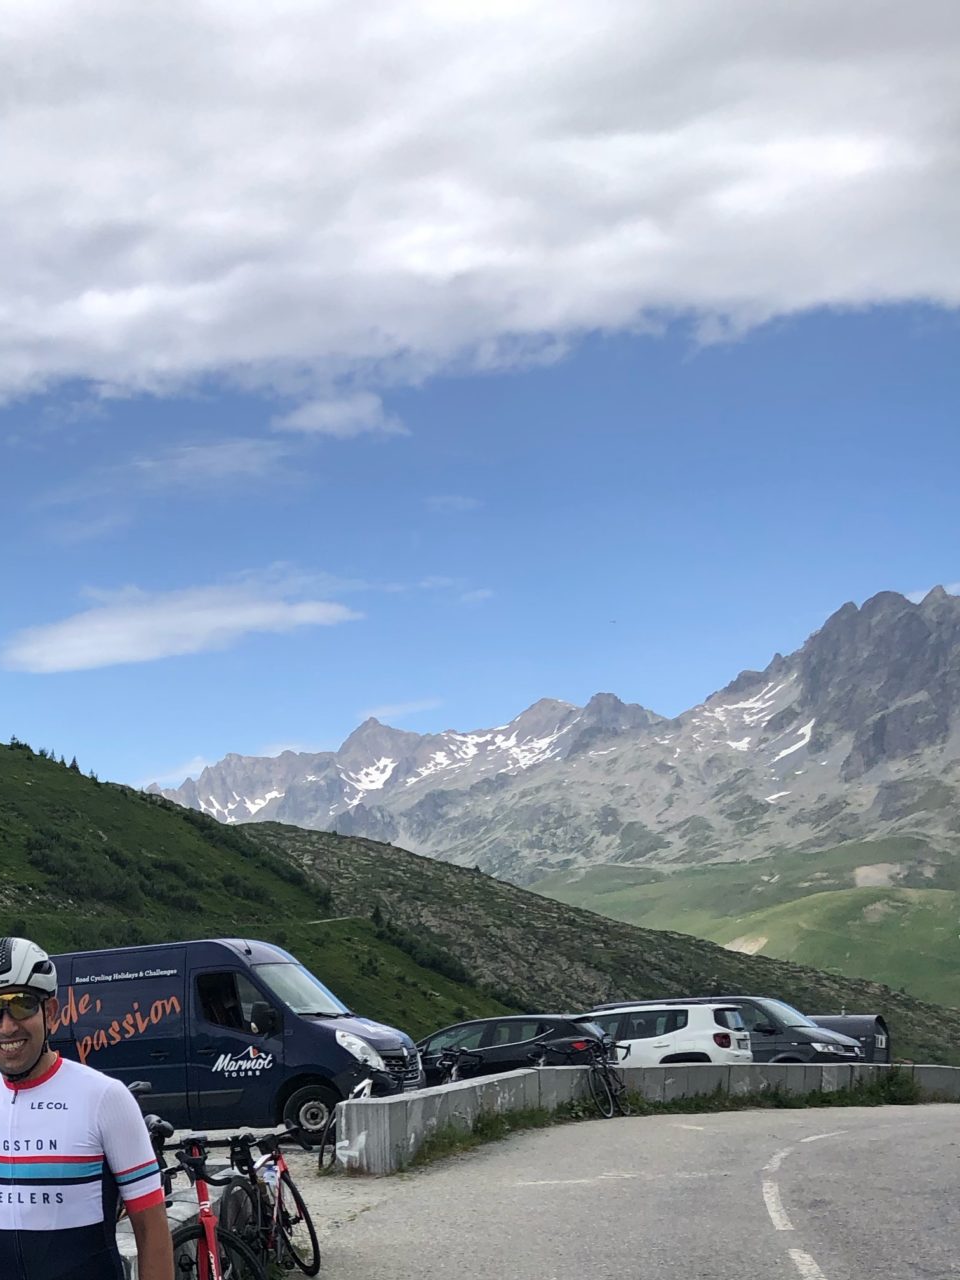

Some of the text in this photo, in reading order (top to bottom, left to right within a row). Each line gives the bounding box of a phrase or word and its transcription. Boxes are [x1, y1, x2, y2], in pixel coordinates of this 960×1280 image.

[113, 971, 138, 980] Holidays
[145, 969, 177, 977] Challenges
[76, 996, 180, 1064] passion
[211, 1053, 273, 1072] Marmot
[31, 1102, 68, 1110] LE COL
